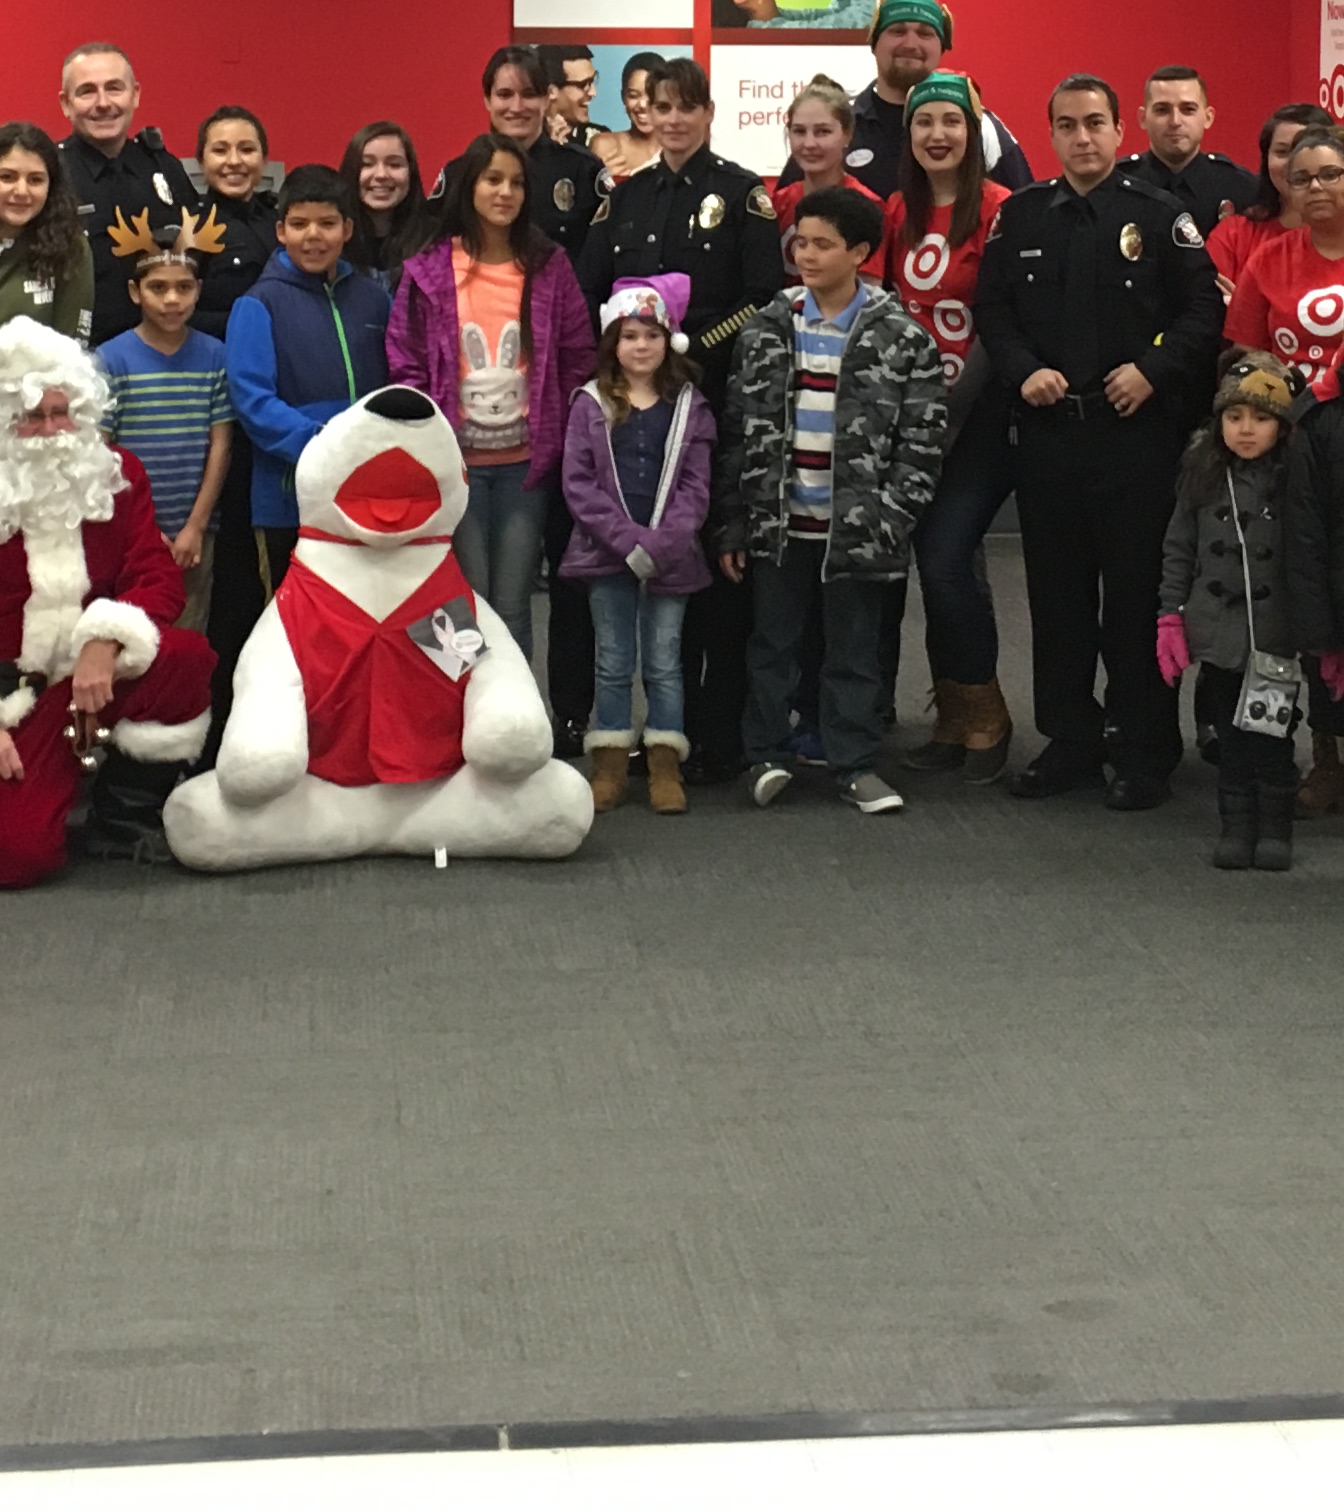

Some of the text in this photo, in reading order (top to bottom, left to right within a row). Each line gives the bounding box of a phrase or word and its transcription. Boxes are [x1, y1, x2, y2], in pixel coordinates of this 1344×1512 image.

[739, 79, 808, 99] Find th
[738, 106, 790, 130] perfe
